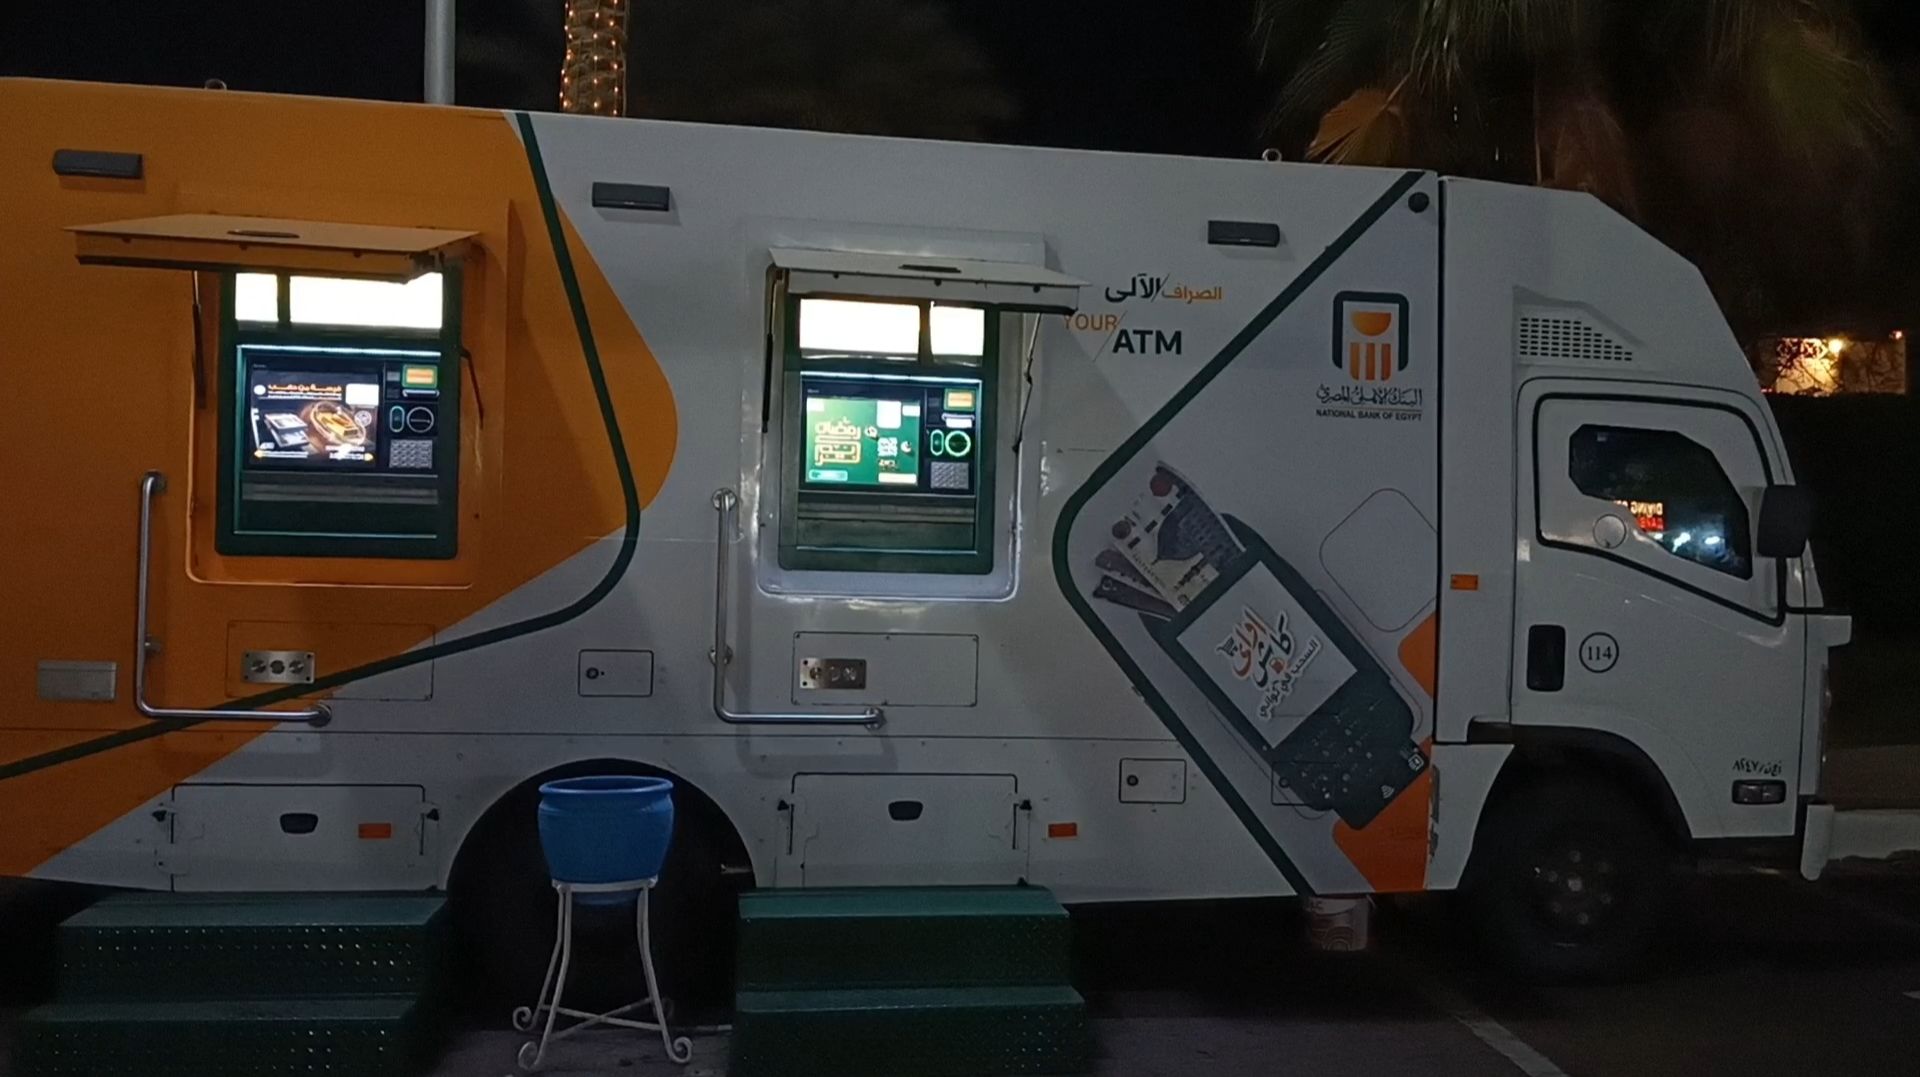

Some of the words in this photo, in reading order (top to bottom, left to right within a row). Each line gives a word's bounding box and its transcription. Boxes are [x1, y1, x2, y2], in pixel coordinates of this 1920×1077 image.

[1161, 283, 1222, 304] الصراف
[1063, 312, 1119, 331] YOUR
[1112, 329, 1182, 355] ATM
[1315, 409, 1356, 419] NATIONAL
[1358, 411, 1381, 420] BANK
[1382, 412, 1394, 420] OF
[1395, 413, 1423, 422] EGYPT
[1291, 639, 1319, 675] السحب
[1587, 646, 1613, 662] 114
